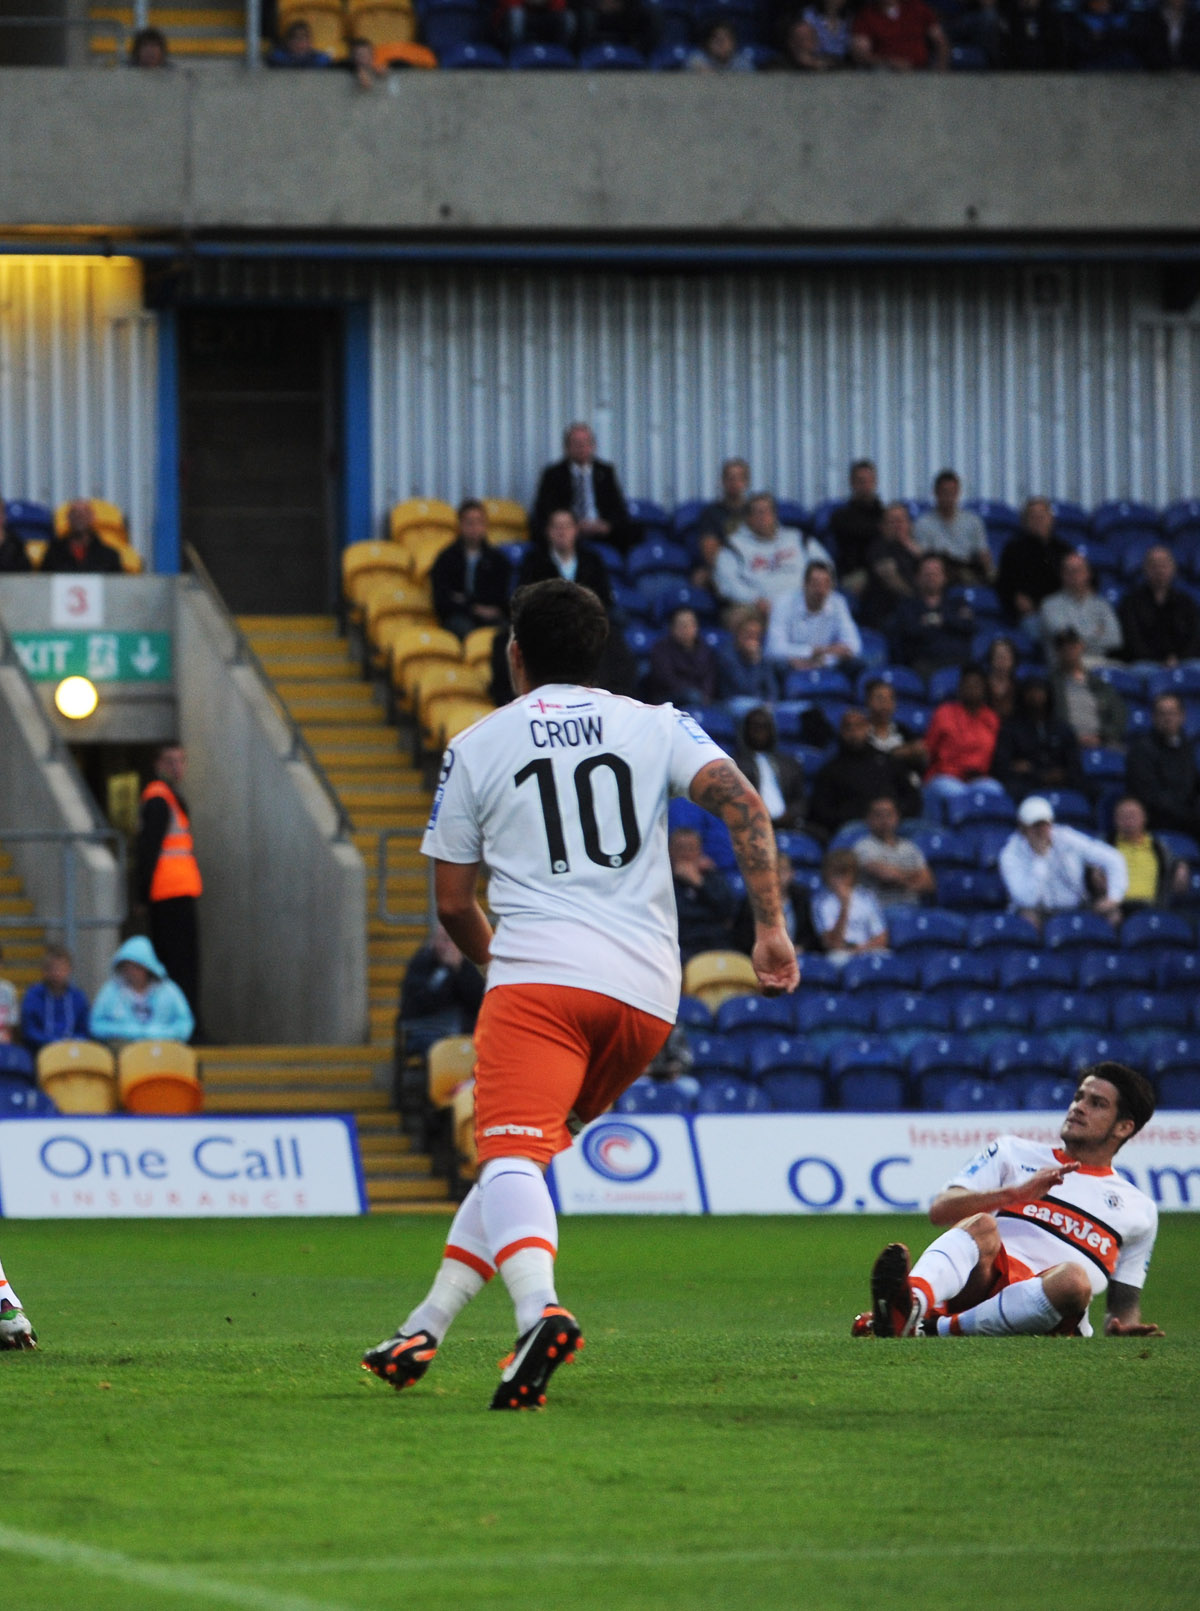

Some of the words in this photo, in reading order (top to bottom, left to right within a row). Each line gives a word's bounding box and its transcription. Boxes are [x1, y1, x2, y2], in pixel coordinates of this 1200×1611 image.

[66, 585, 89, 617] 3
[13, 639, 74, 674] XIT
[530, 716, 603, 748] CROW
[514, 753, 641, 874] 10
[39, 1135, 169, 1179] One
[193, 1135, 303, 1180] Call
[50, 1190, 308, 1209] INSURANCE
[787, 1155, 920, 1211] O.C
[1022, 1204, 1112, 1255] easyJet
